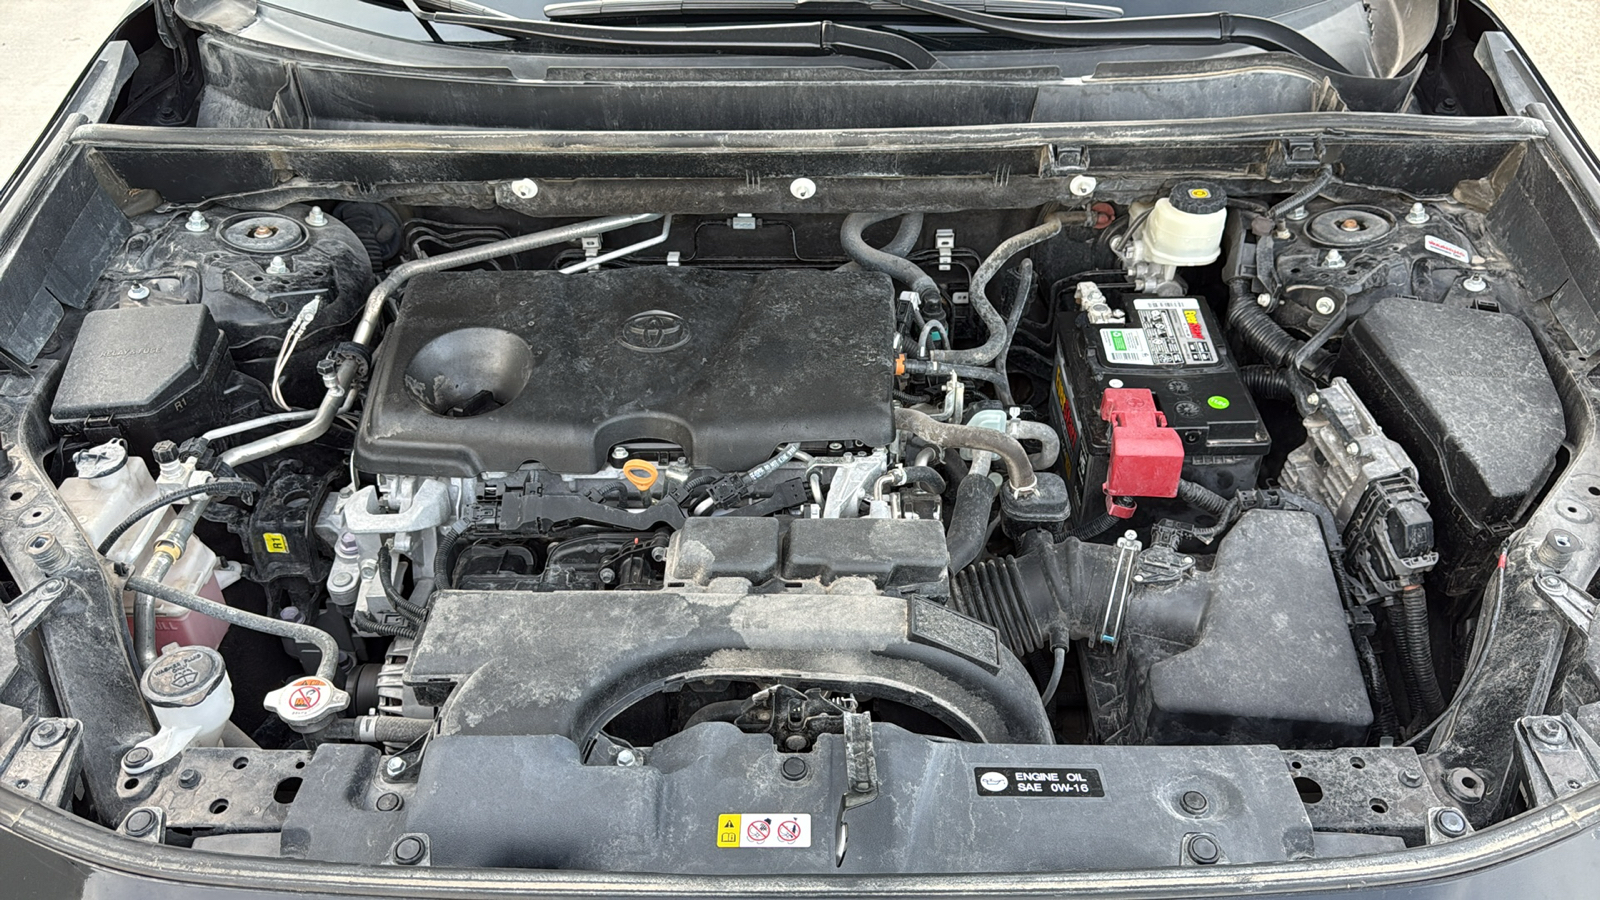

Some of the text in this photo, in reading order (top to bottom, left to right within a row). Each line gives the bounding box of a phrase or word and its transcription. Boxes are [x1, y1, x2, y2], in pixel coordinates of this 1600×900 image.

[174, 397, 188, 412] R1
[271, 538, 283, 549] R1
[154, 653, 202, 677] WASHER FLUID
[1015, 772, 1088, 783] ENGINE OIL
[1017, 783, 1089, 793] SAE 0W-16
